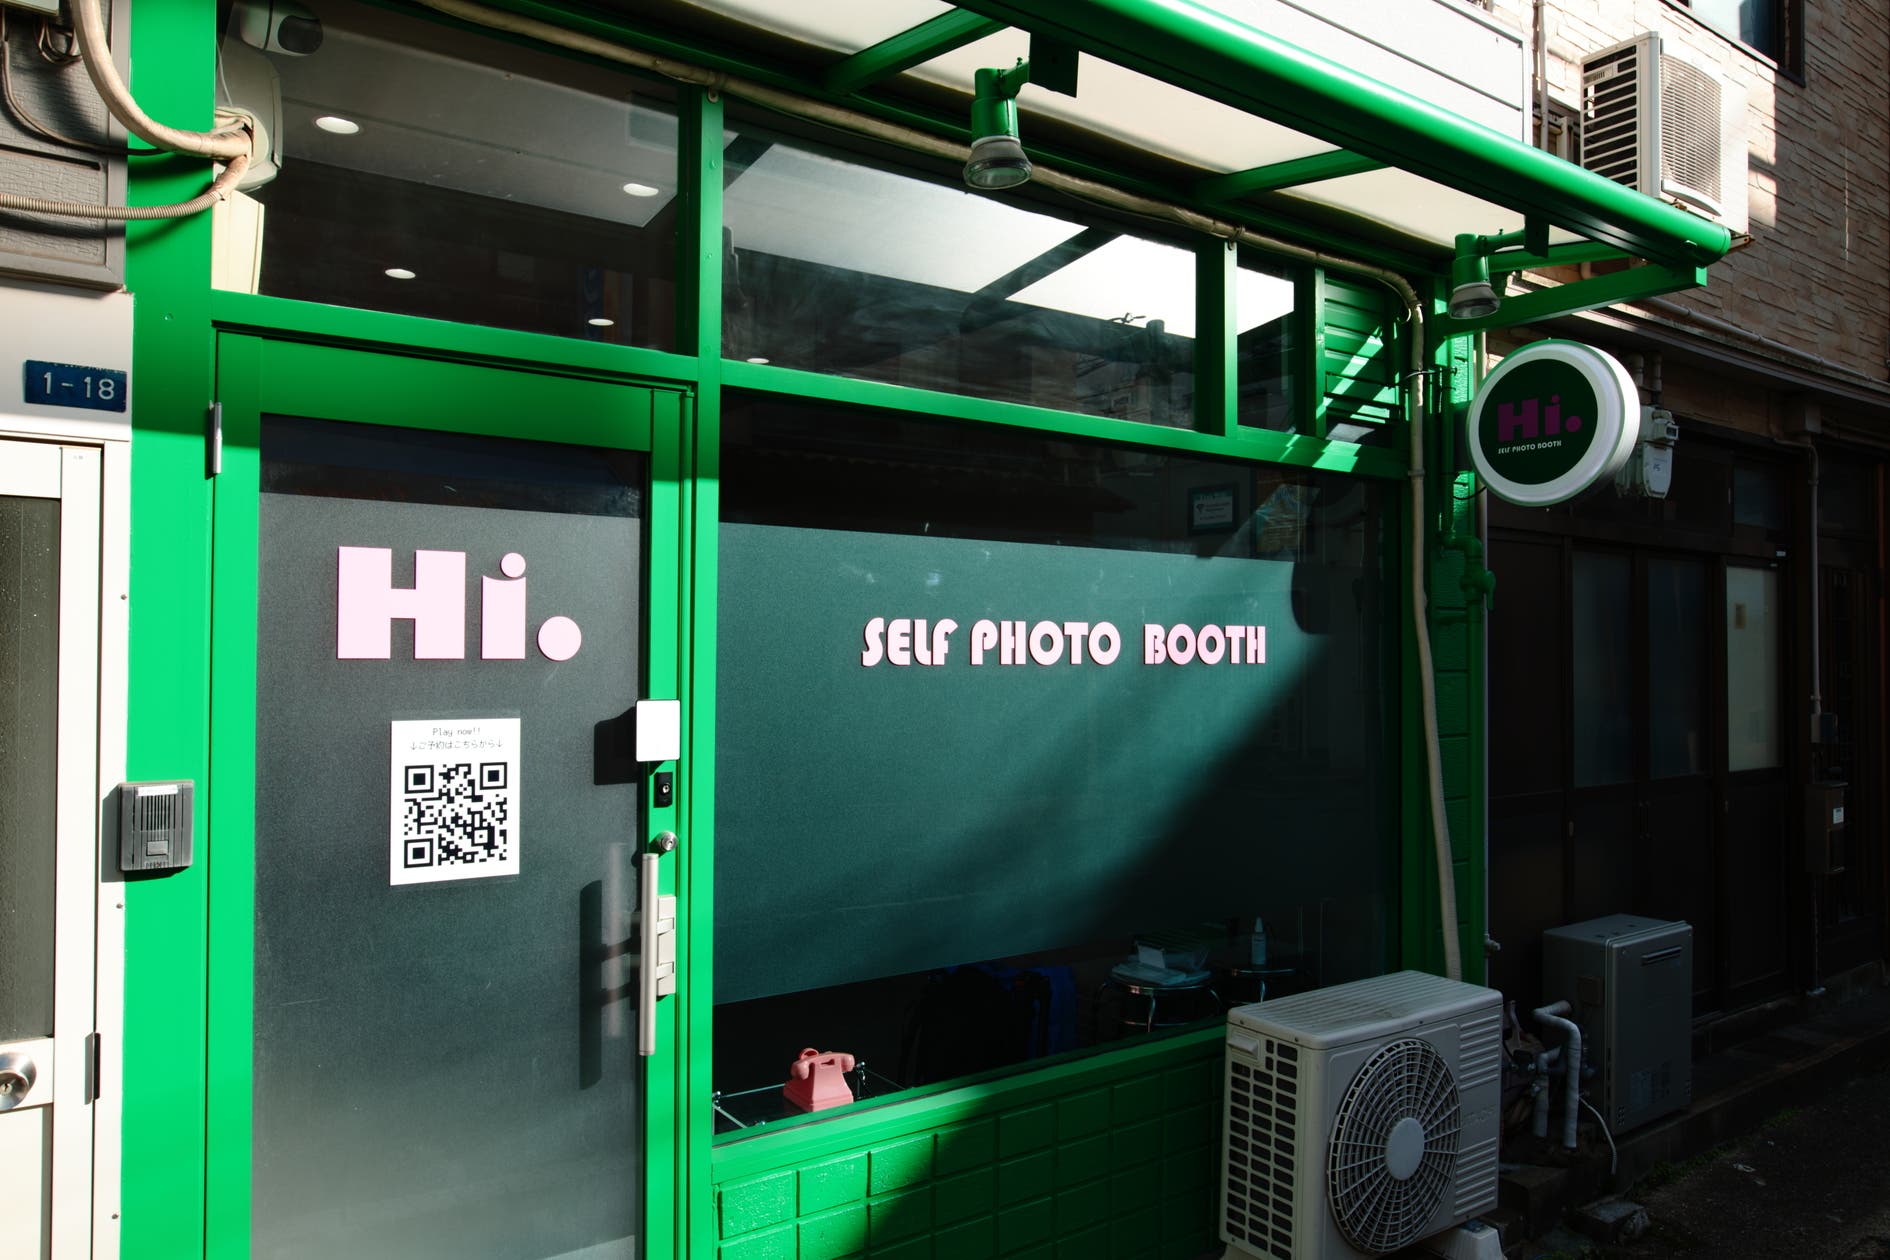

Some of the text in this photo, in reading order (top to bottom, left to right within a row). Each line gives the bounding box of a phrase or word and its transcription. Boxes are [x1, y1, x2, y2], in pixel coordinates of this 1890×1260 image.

[43, 371, 115, 400] 1-18
[1498, 395, 1582, 441] Hi.
[1512, 443, 1536, 453] PHOTO
[1537, 439, 1562, 449] BOOTH
[338, 546, 582, 661] Hi.
[861, 616, 1267, 668] SELF PHOTO BOOTH
[432, 727, 453, 737] Play
